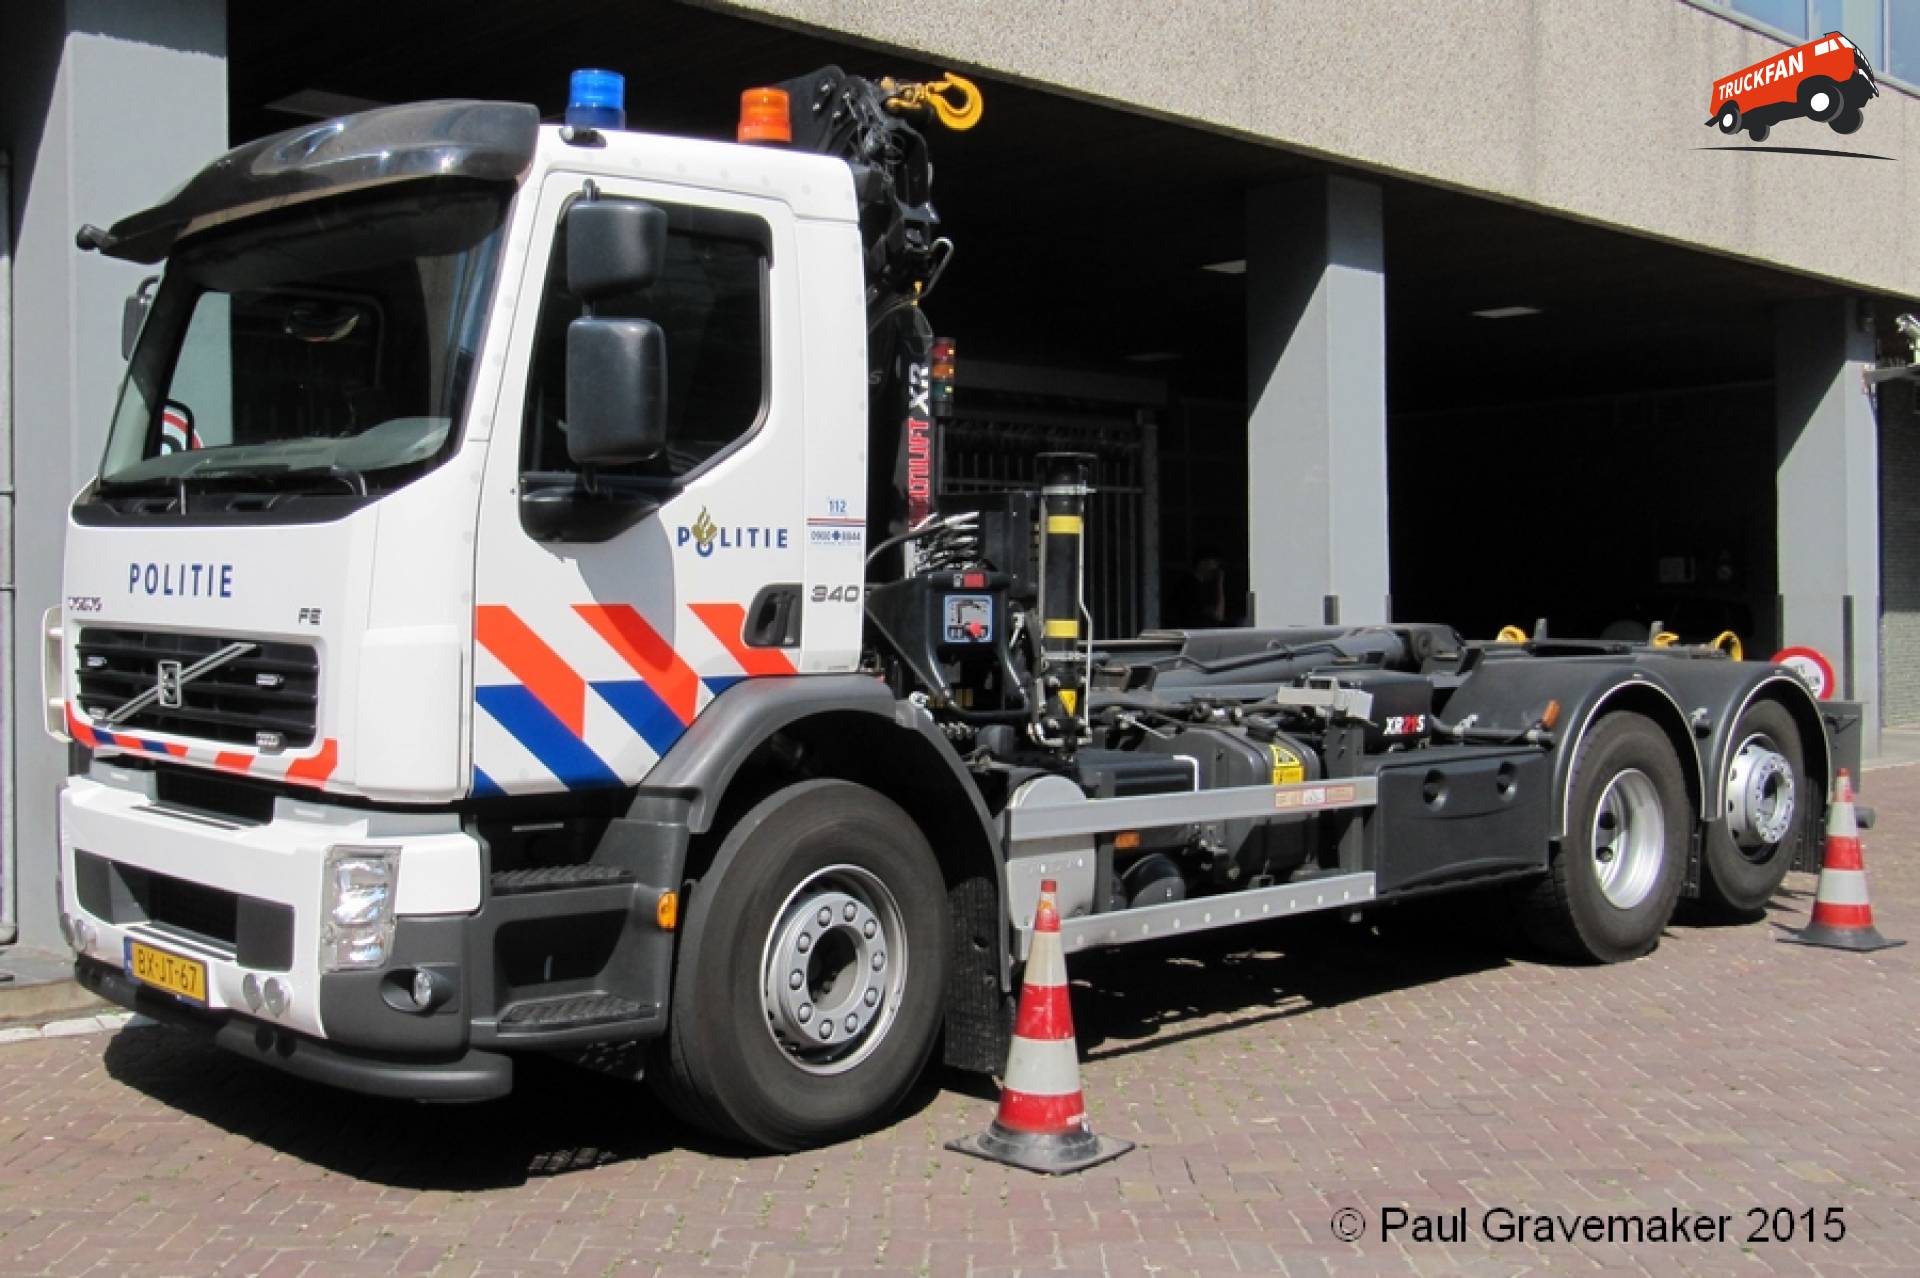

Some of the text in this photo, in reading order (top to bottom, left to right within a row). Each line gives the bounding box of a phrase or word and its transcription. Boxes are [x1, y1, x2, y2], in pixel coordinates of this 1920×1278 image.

[908, 362, 930, 416] XR
[829, 499, 847, 513] 112
[677, 526, 789, 557] POLITIE
[129, 563, 233, 598] POLITIE
[810, 584, 861, 602] 340
[298, 607, 322, 625] FE
[137, 947, 198, 992] BX-JT-67
